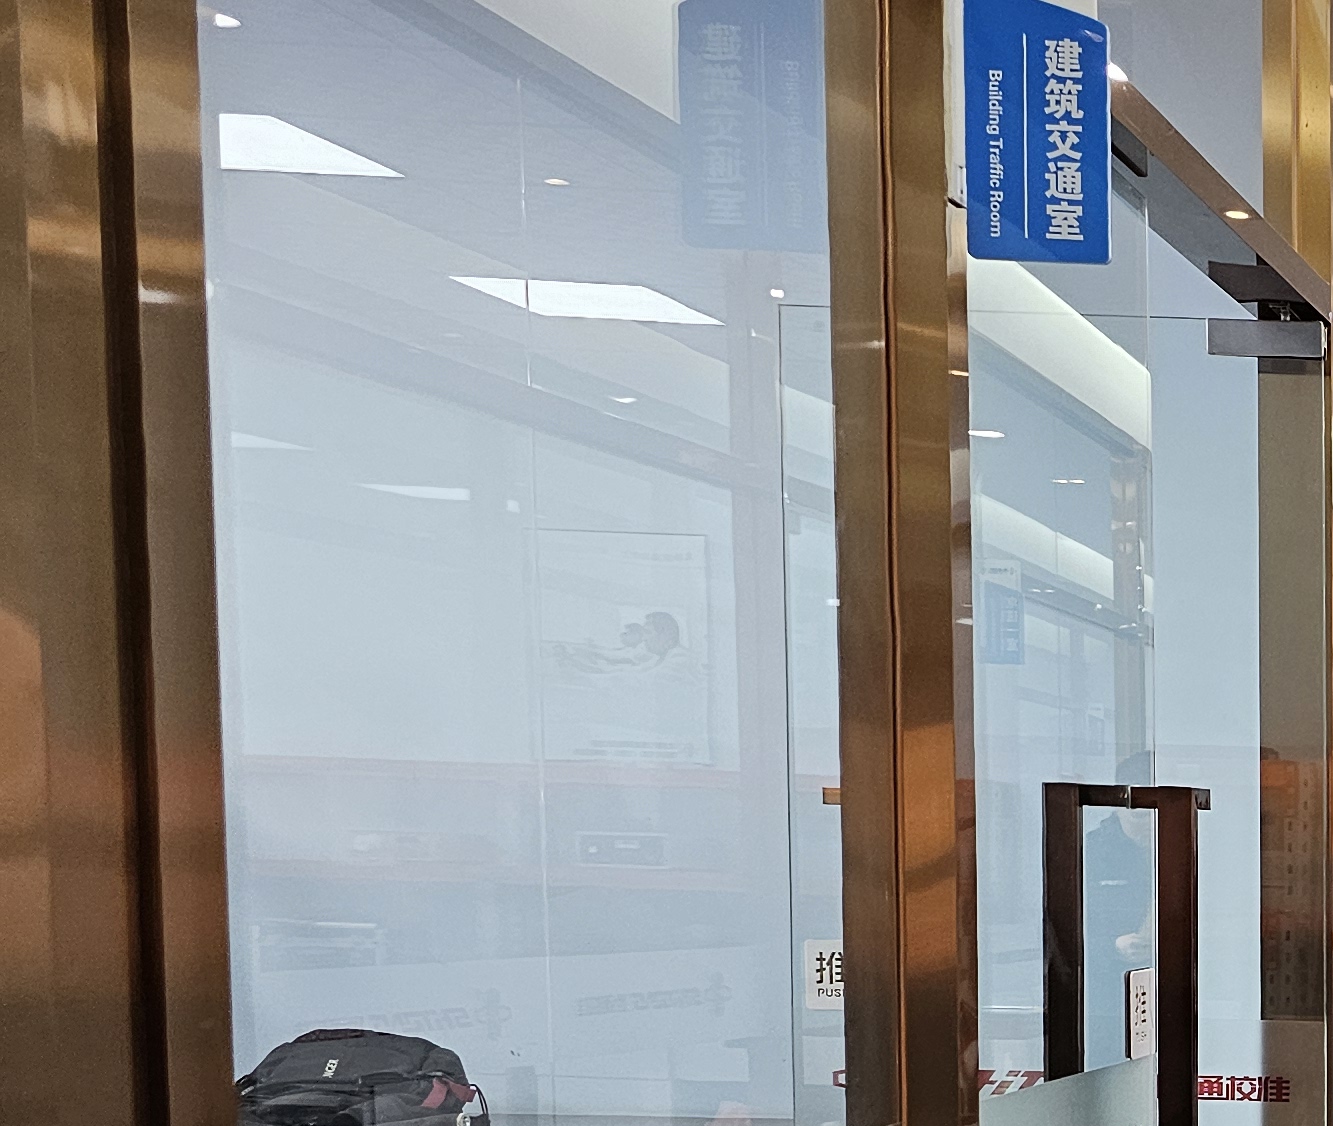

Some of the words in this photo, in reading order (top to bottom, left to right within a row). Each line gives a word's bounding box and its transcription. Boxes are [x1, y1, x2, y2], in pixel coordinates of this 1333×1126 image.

[986, 69, 1003, 135] Building
[989, 137, 1004, 188] Traffic
[1044, 38, 1084, 241] 建筑交通室
[990, 191, 1004, 237] Room
[816, 952, 844, 984] 推
[1197, 1075, 1290, 1102] 通校准
